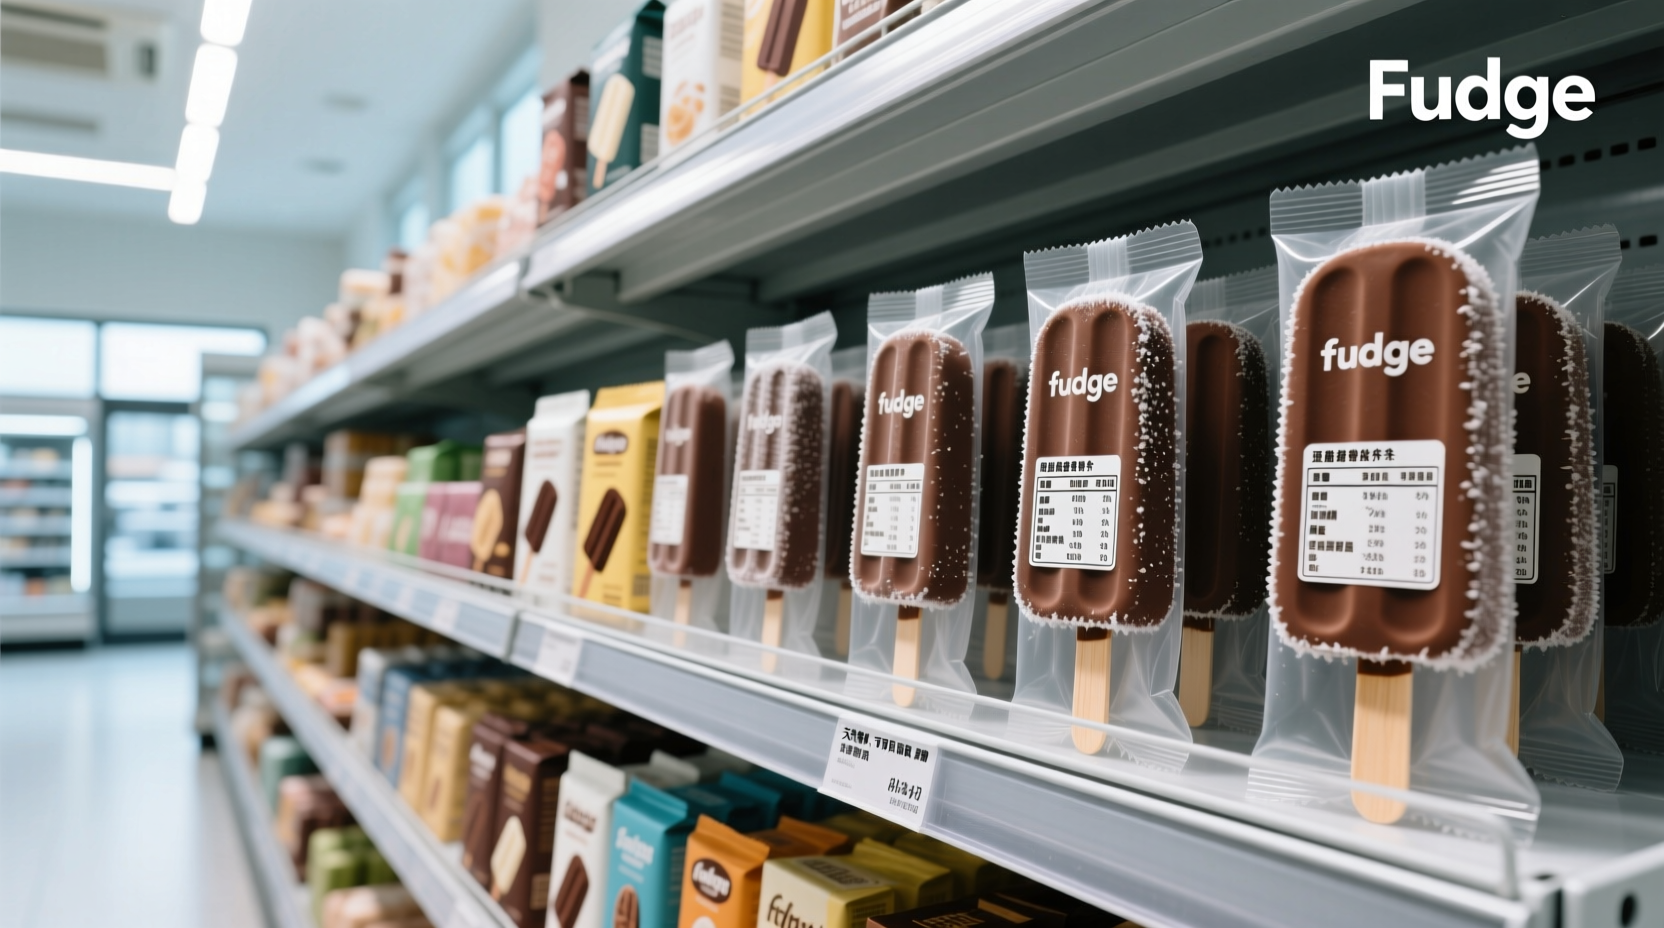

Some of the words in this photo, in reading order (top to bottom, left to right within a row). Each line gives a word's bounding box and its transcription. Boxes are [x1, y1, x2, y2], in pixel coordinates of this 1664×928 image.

[1320, 331, 1436, 377] fudge
[1048, 367, 1119, 403] fudge
[877, 389, 925, 419] fudge
